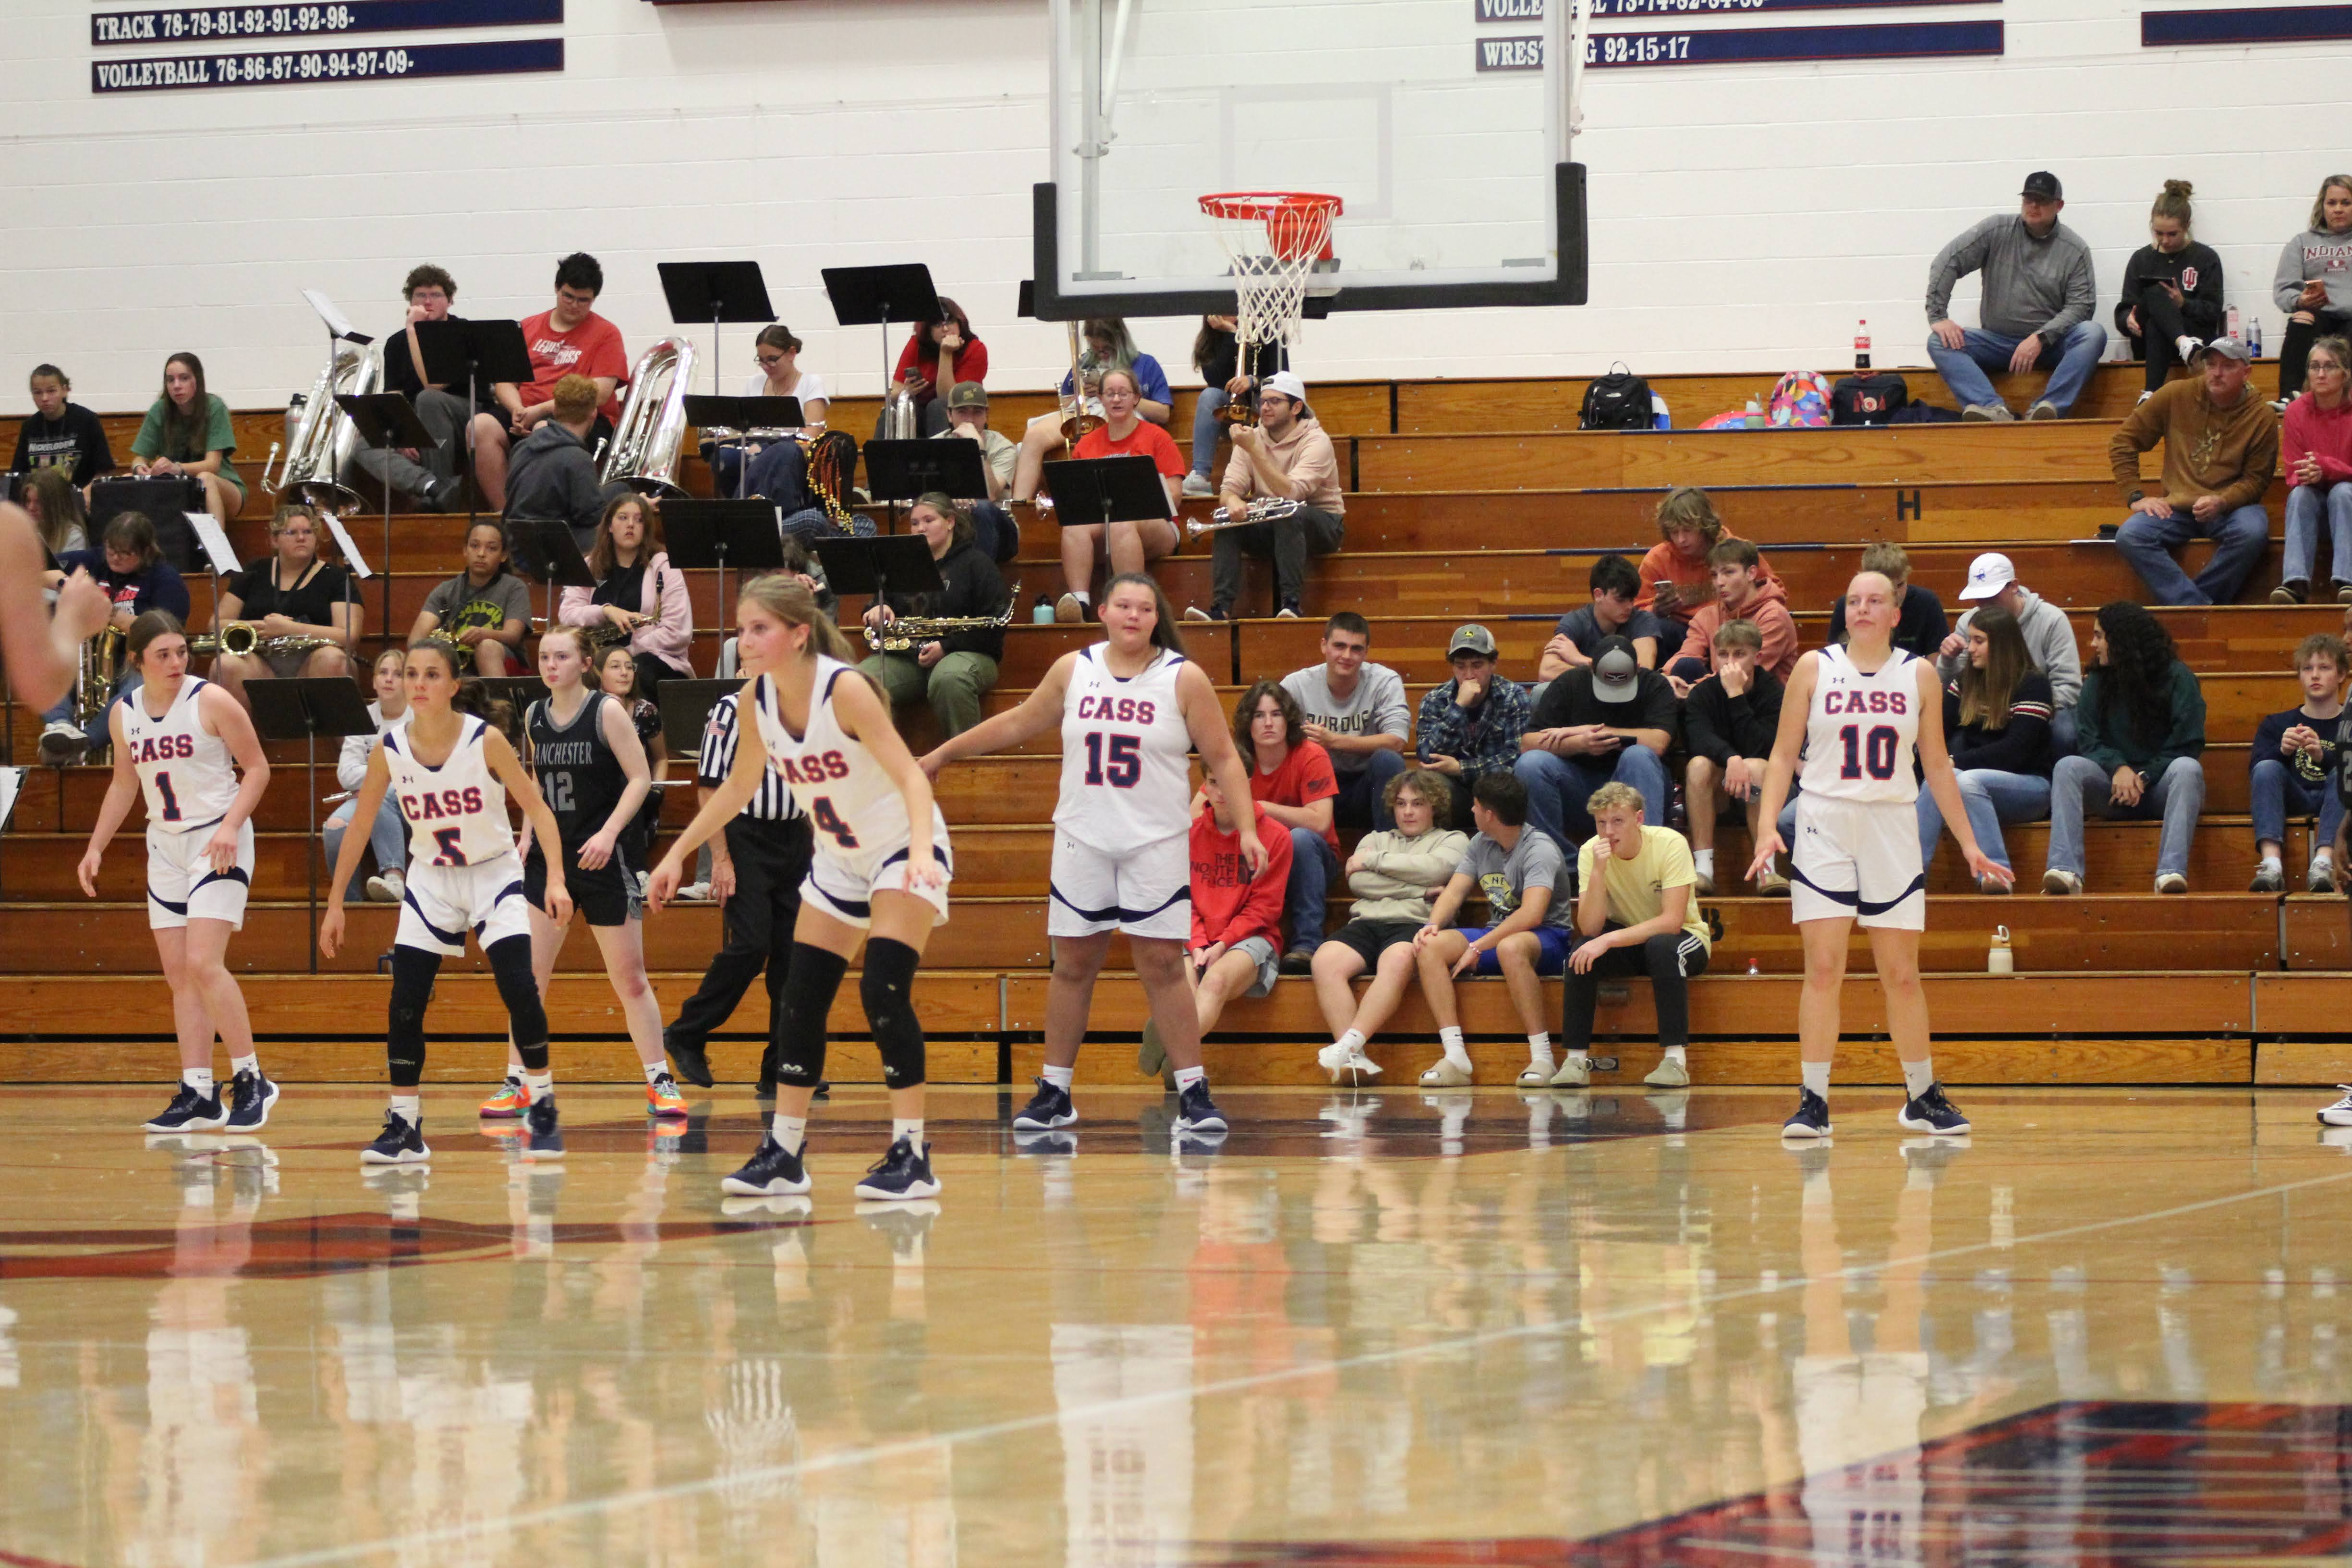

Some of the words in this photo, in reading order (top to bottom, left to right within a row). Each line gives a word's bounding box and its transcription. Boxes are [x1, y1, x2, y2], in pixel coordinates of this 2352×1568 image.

[96, 15, 156, 40] TRACK
[162, 5, 355, 37] 78-79-81-82-91-92-98-
[97, 60, 210, 88] VOLLEYBALL
[216, 49, 414, 82] 76-86-87-90-94-97-09-
[1483, 37, 1597, 66] WRESG
[1604, 36, 1691, 63] 92-15-17
[1897, 490, 1921, 521] H
[1078, 695, 1155, 725] CASS
[1825, 690, 1907, 716] CASS
[130, 733, 194, 765] CASS
[534, 741, 593, 766] ANCHESTER
[769, 749, 850, 784] ASS
[1084, 731, 1141, 789] 15
[1839, 724, 1900, 780] 10
[155, 771, 182, 822] 1
[401, 786, 483, 821] CASS
[545, 771, 576, 811] 12
[812, 796, 861, 849] 4
[433, 827, 469, 866] 5
